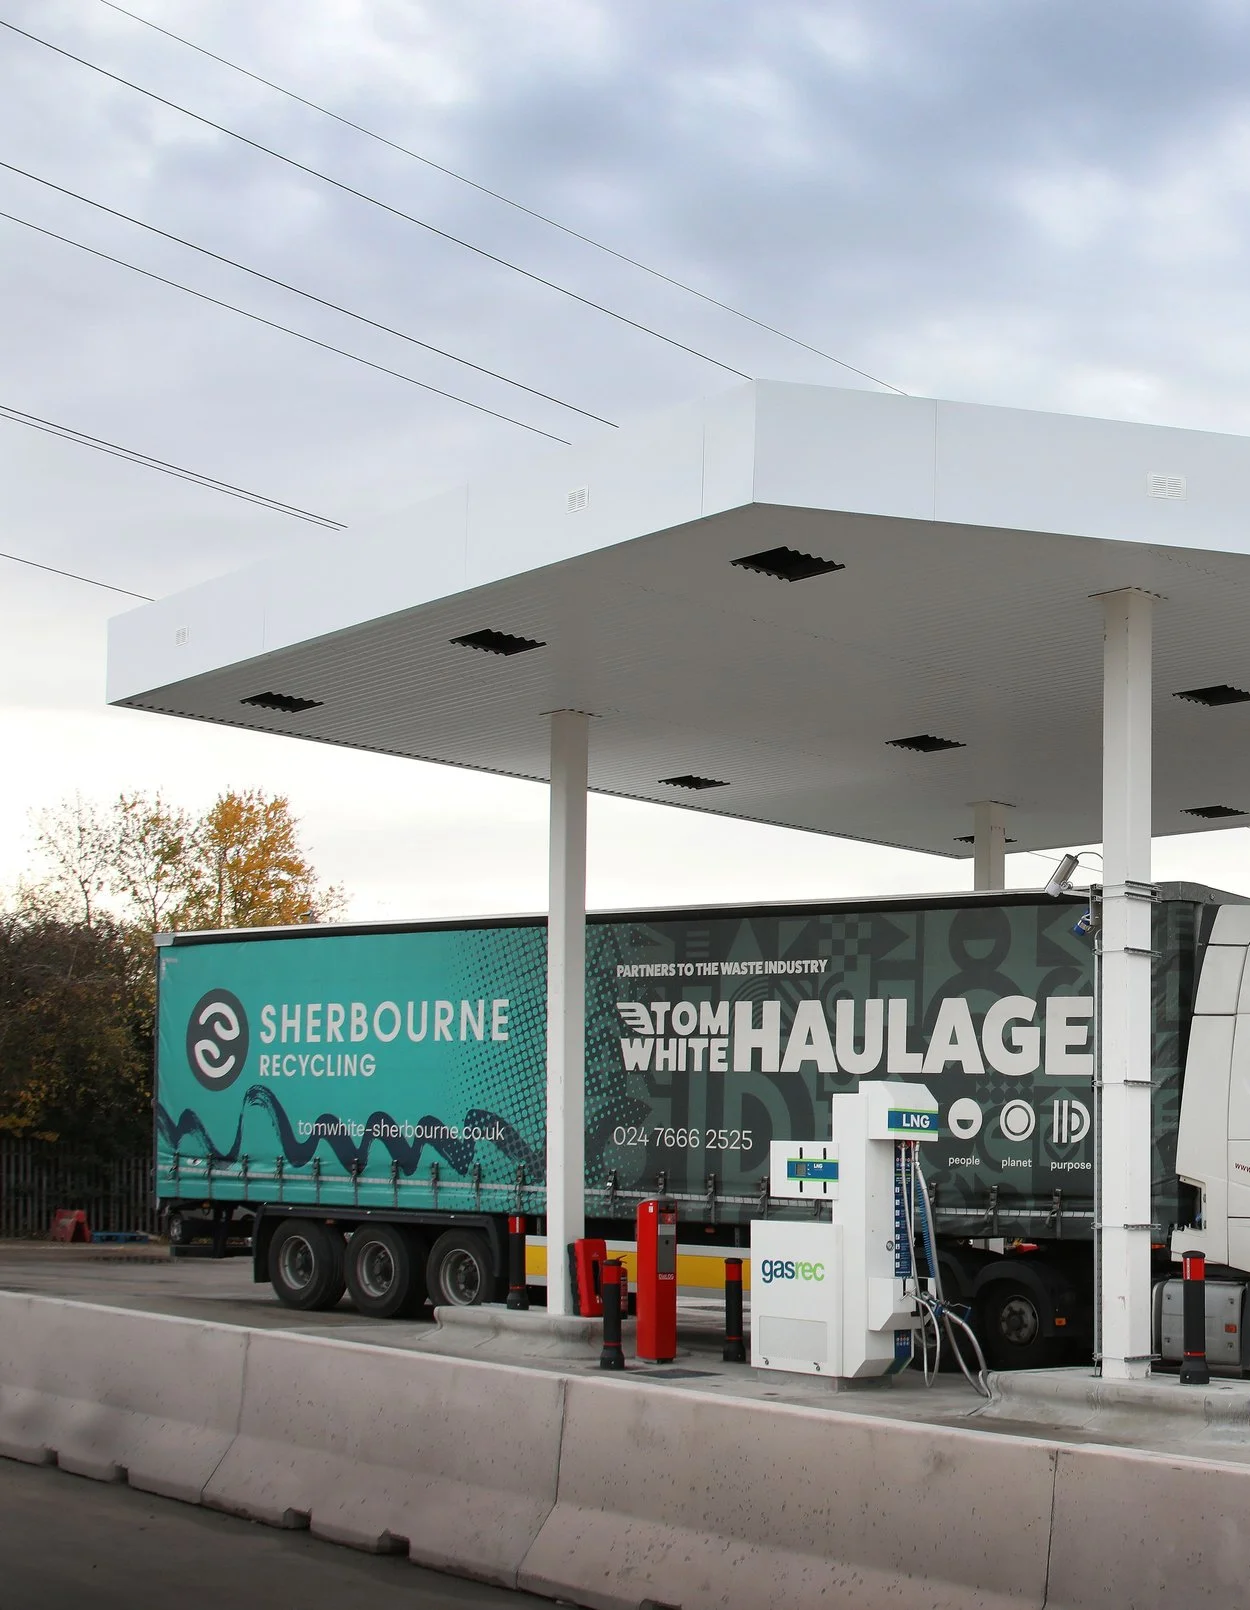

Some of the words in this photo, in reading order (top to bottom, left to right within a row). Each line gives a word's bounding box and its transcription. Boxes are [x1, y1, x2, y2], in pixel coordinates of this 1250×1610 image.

[616, 963, 676, 978] PARTNERS
[677, 962, 694, 977] TO
[695, 962, 719, 976] THE
[720, 961, 763, 976] WASTE
[764, 959, 828, 975] INDUSTRY
[259, 999, 510, 1044] SHERBOURNE
[651, 1001, 730, 1036] TOM
[734, 995, 1093, 1076] HAULAGE
[259, 1053, 377, 1078] RECYCLING
[620, 1037, 729, 1072] WHITE
[298, 1117, 505, 1142] tomwhite-sherbourne.co.uk
[902, 1113, 930, 1129] LNG
[613, 1126, 650, 1146] 024
[654, 1127, 700, 1148] 7666
[705, 1129, 753, 1150] 2525
[948, 1155, 981, 1167] people
[1001, 1157, 1032, 1169] planet
[1050, 1161, 1092, 1171] purpose
[761, 1259, 825, 1284] gasrec
